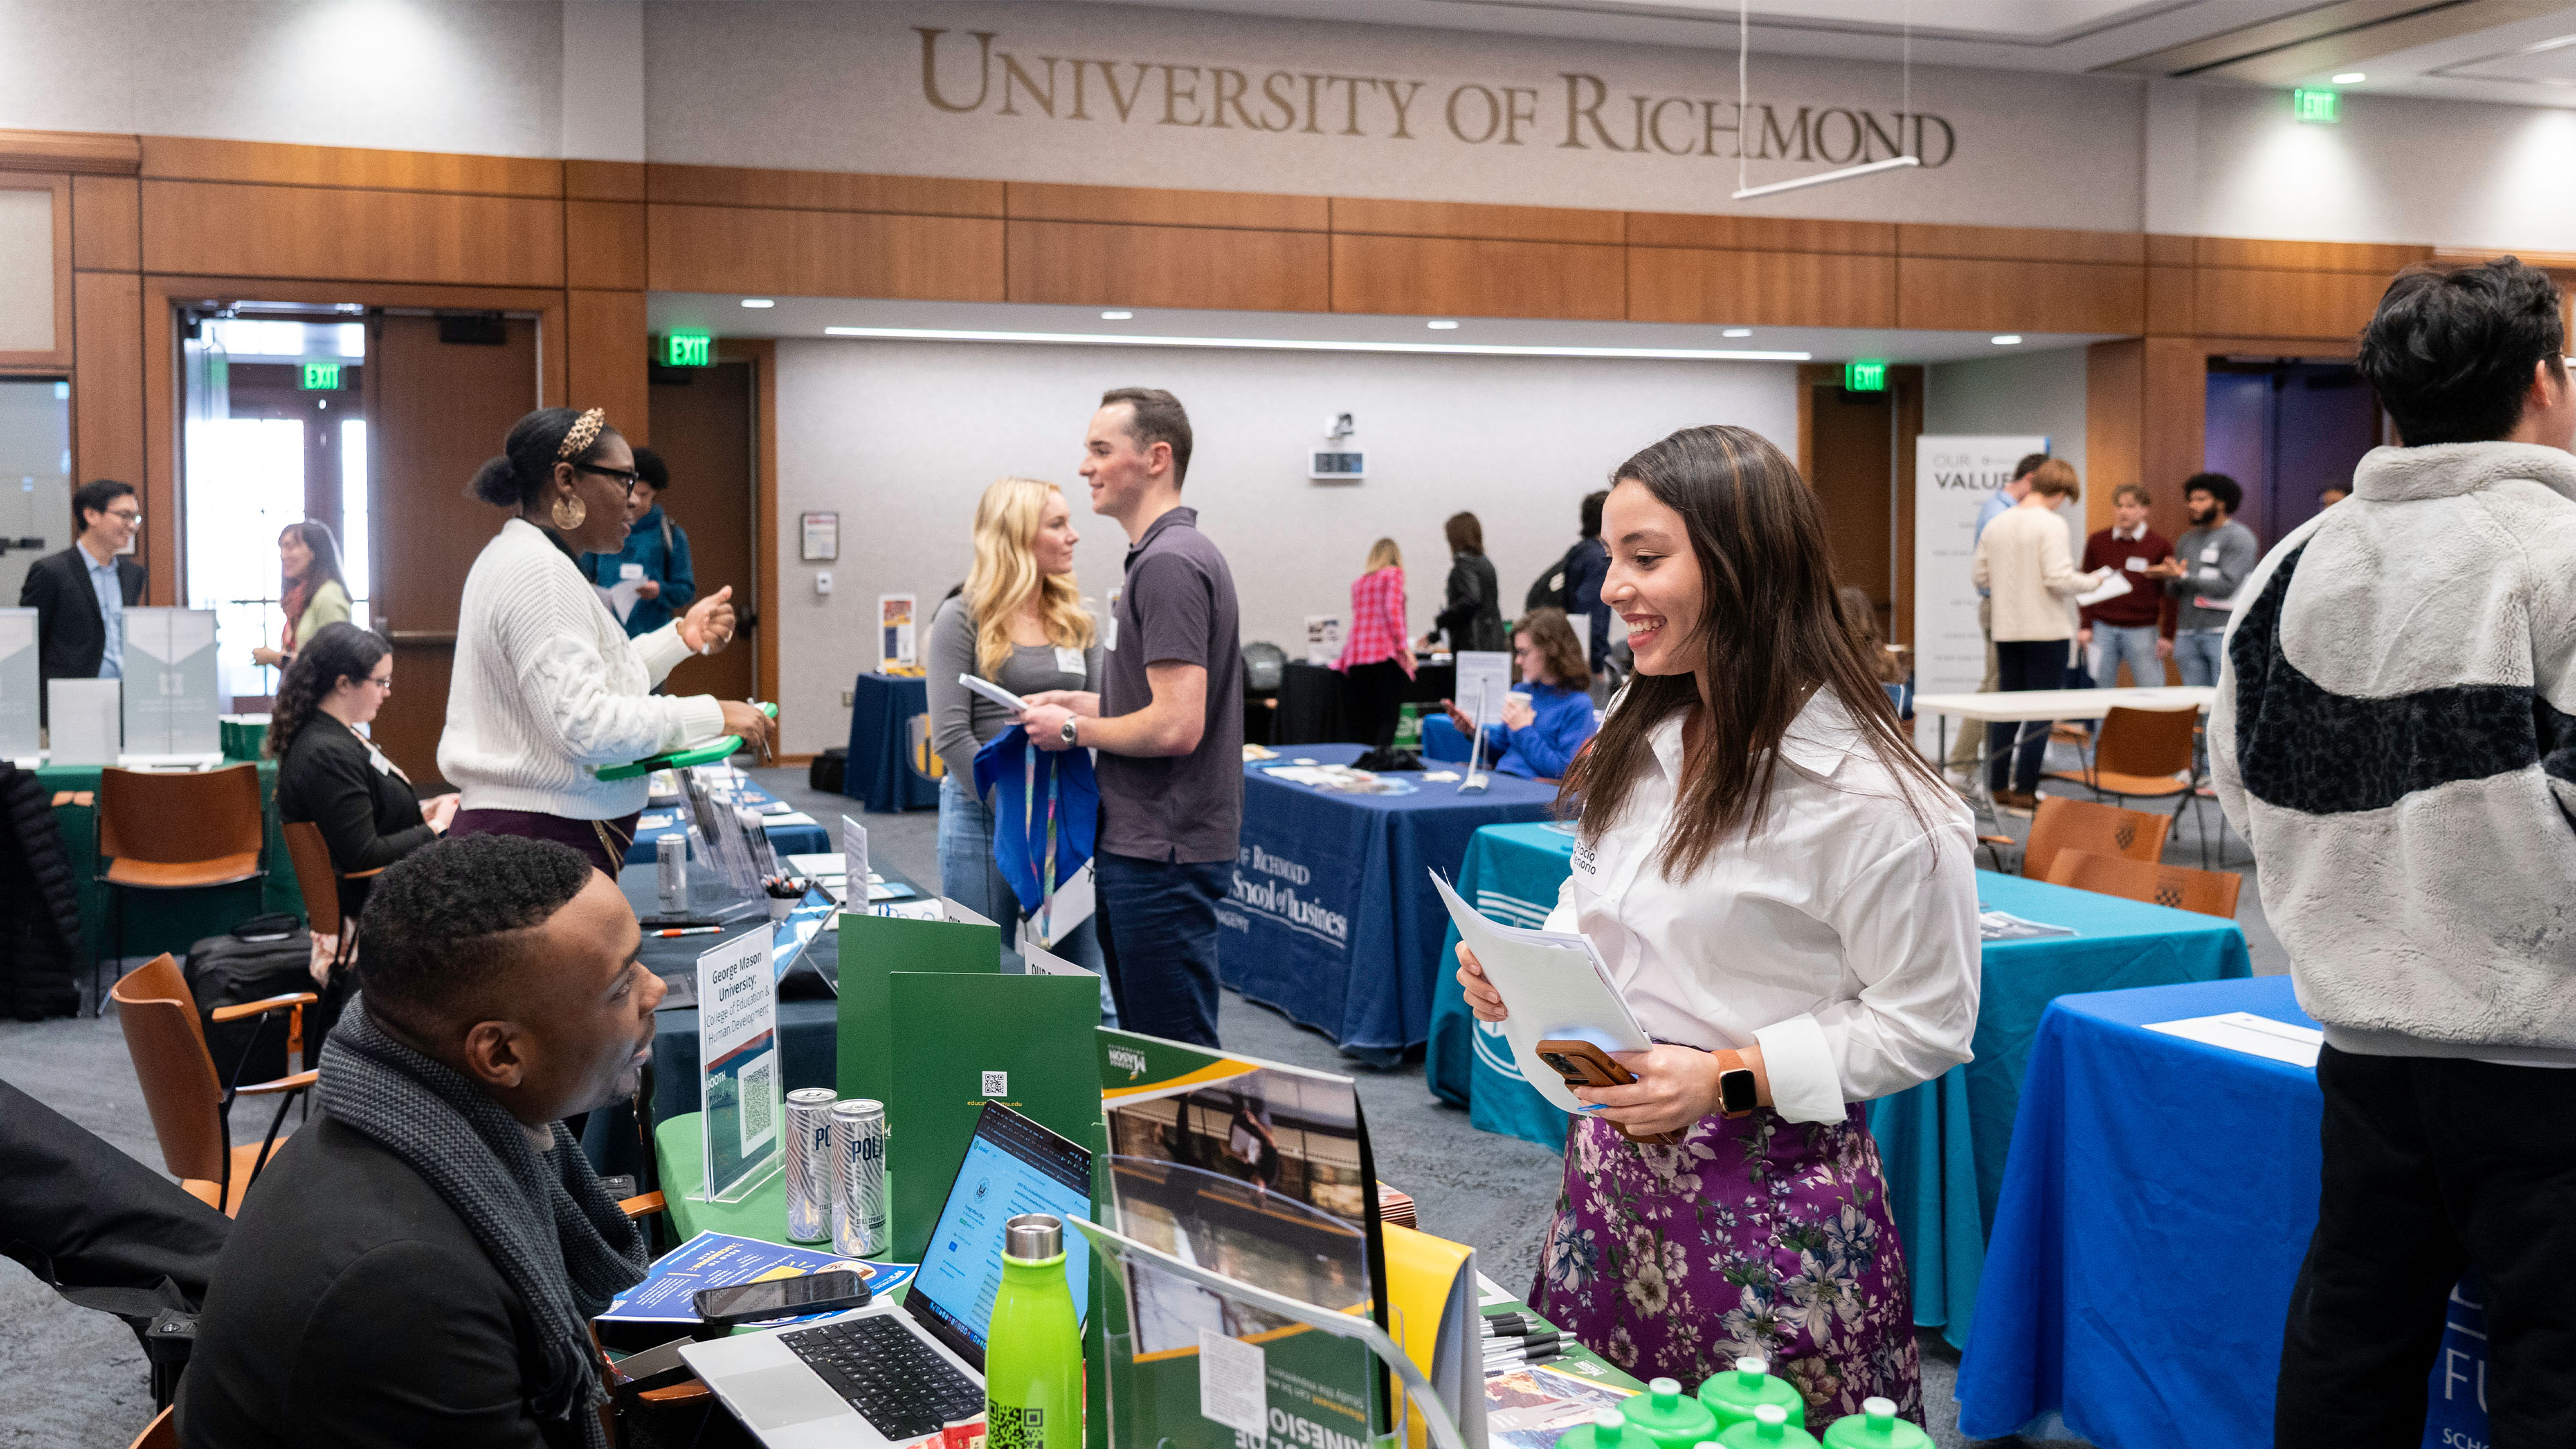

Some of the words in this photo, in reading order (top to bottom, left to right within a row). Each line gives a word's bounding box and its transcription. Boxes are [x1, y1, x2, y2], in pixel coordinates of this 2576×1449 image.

[910, 25, 1426, 140] UNIVERSITY
[1444, 83, 1537, 146] OF
[1557, 72, 1956, 168] RICHMOND
[669, 335, 711, 366] EXIT
[303, 362, 341, 390] EXIT
[1854, 363, 1886, 391] EXIT
[712, 963, 738, 985] George
[739, 952, 762, 972] Mason
[718, 975, 757, 1002] University:
[706, 1008, 728, 1028] College
[729, 1002, 735, 1016] of
[737, 990, 764, 1012] Education
[765, 985, 770, 997] &
[708, 1026, 731, 1046] Human
[732, 1004, 769, 1032] Development
[706, 1070, 726, 1091] BOOTH
[697, 1250, 716, 1260] FAIR
[719, 1249, 741, 1260] ROAD
[2442, 1427, 2489, 1449] SCH
